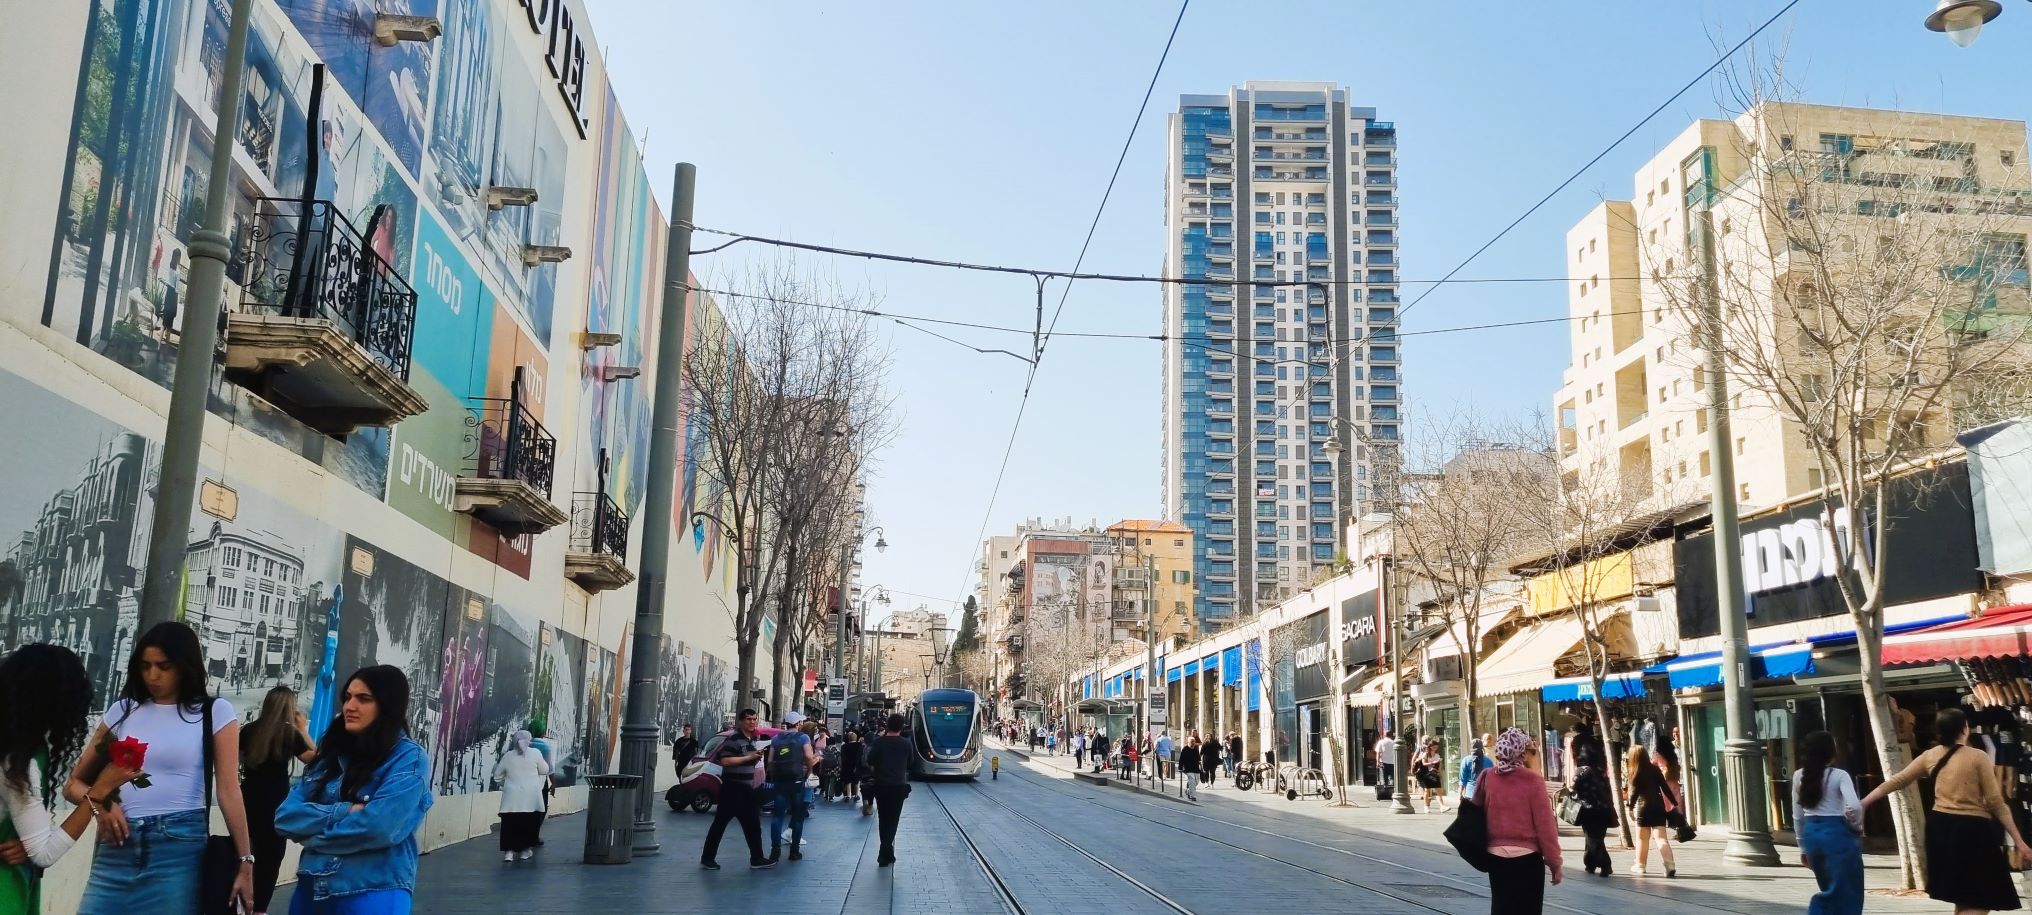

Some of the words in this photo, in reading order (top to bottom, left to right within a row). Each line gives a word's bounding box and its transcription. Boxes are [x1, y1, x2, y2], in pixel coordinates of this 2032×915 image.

[518, 0, 589, 140] OTEL
[424, 241, 462, 316] מסחר
[400, 442, 456, 512] משרדים
[1740, 507, 1872, 613] תמנו
[1341, 614, 1376, 642] SACARA
